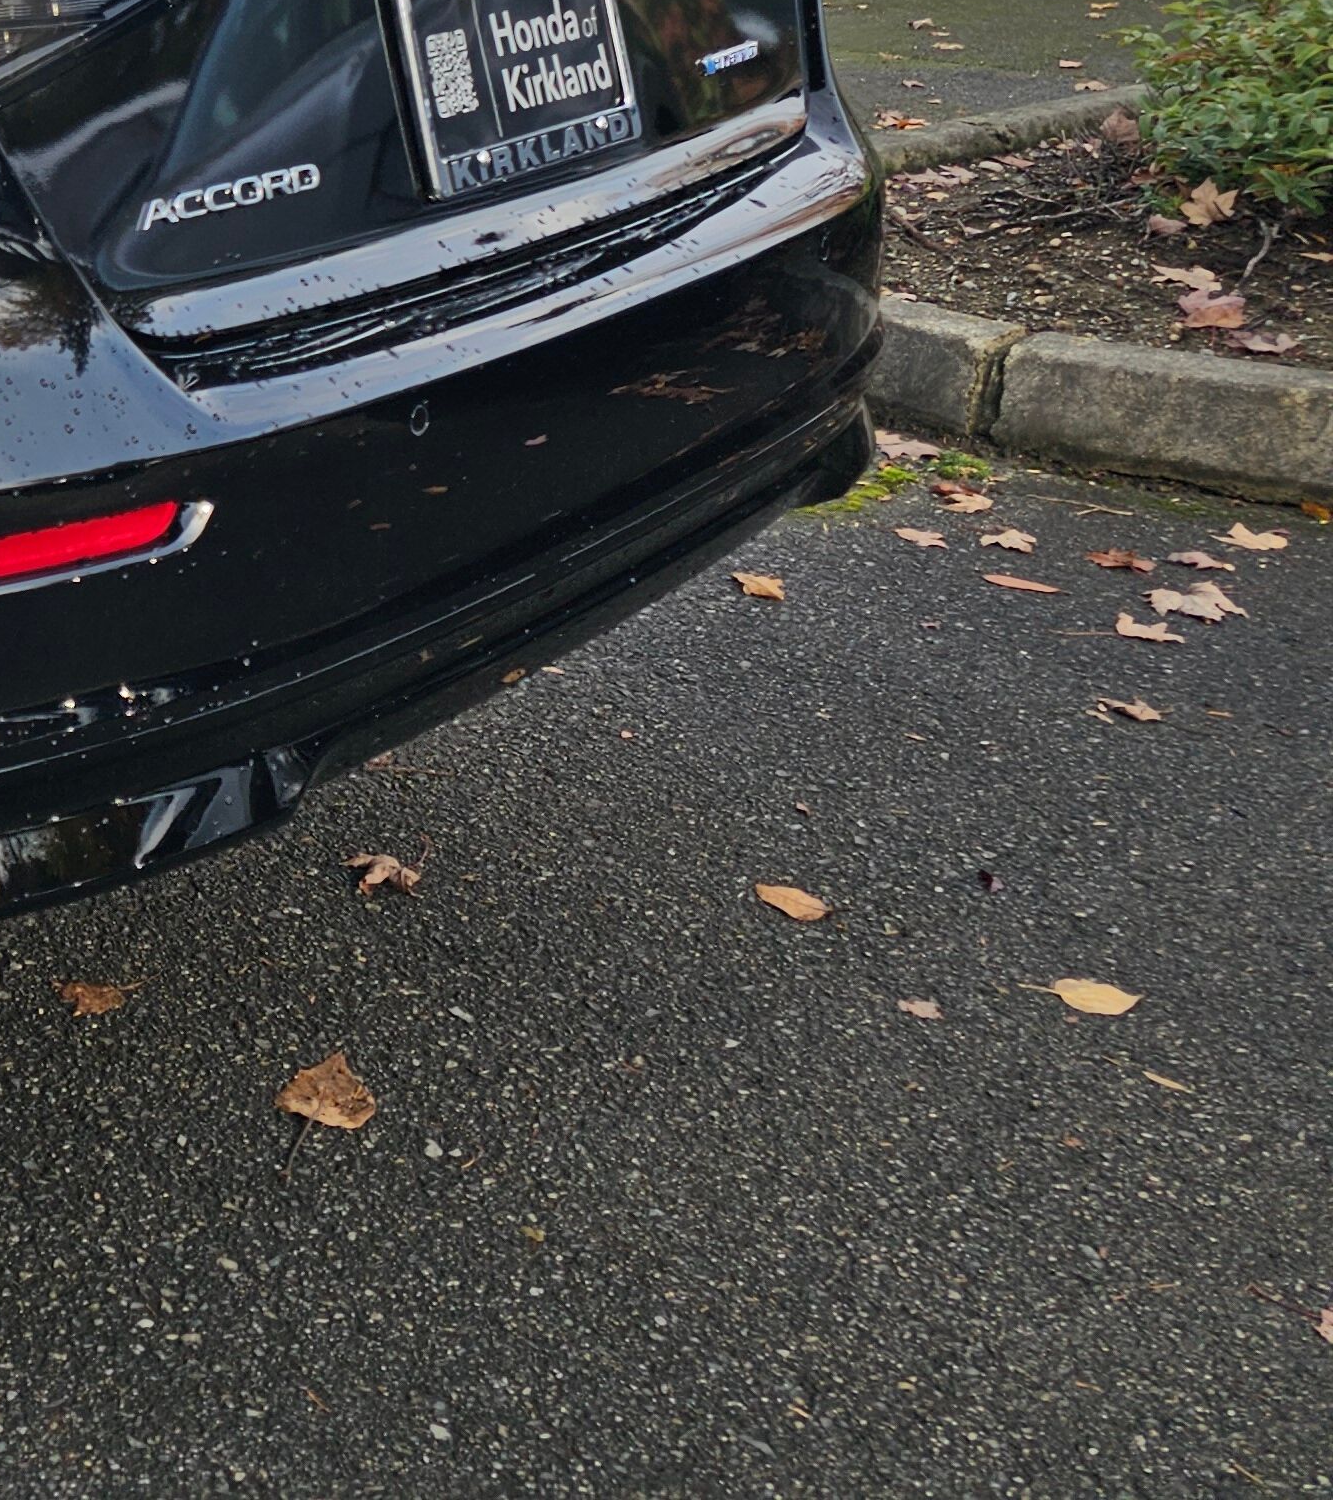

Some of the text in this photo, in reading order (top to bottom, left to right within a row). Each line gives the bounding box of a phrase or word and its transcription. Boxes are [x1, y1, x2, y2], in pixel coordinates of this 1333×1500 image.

[581, 5, 598, 38] of
[501, 42, 613, 113] Kirkland
[451, 112, 630, 190] KIRKLAND
[135, 163, 321, 231] ACCORD
